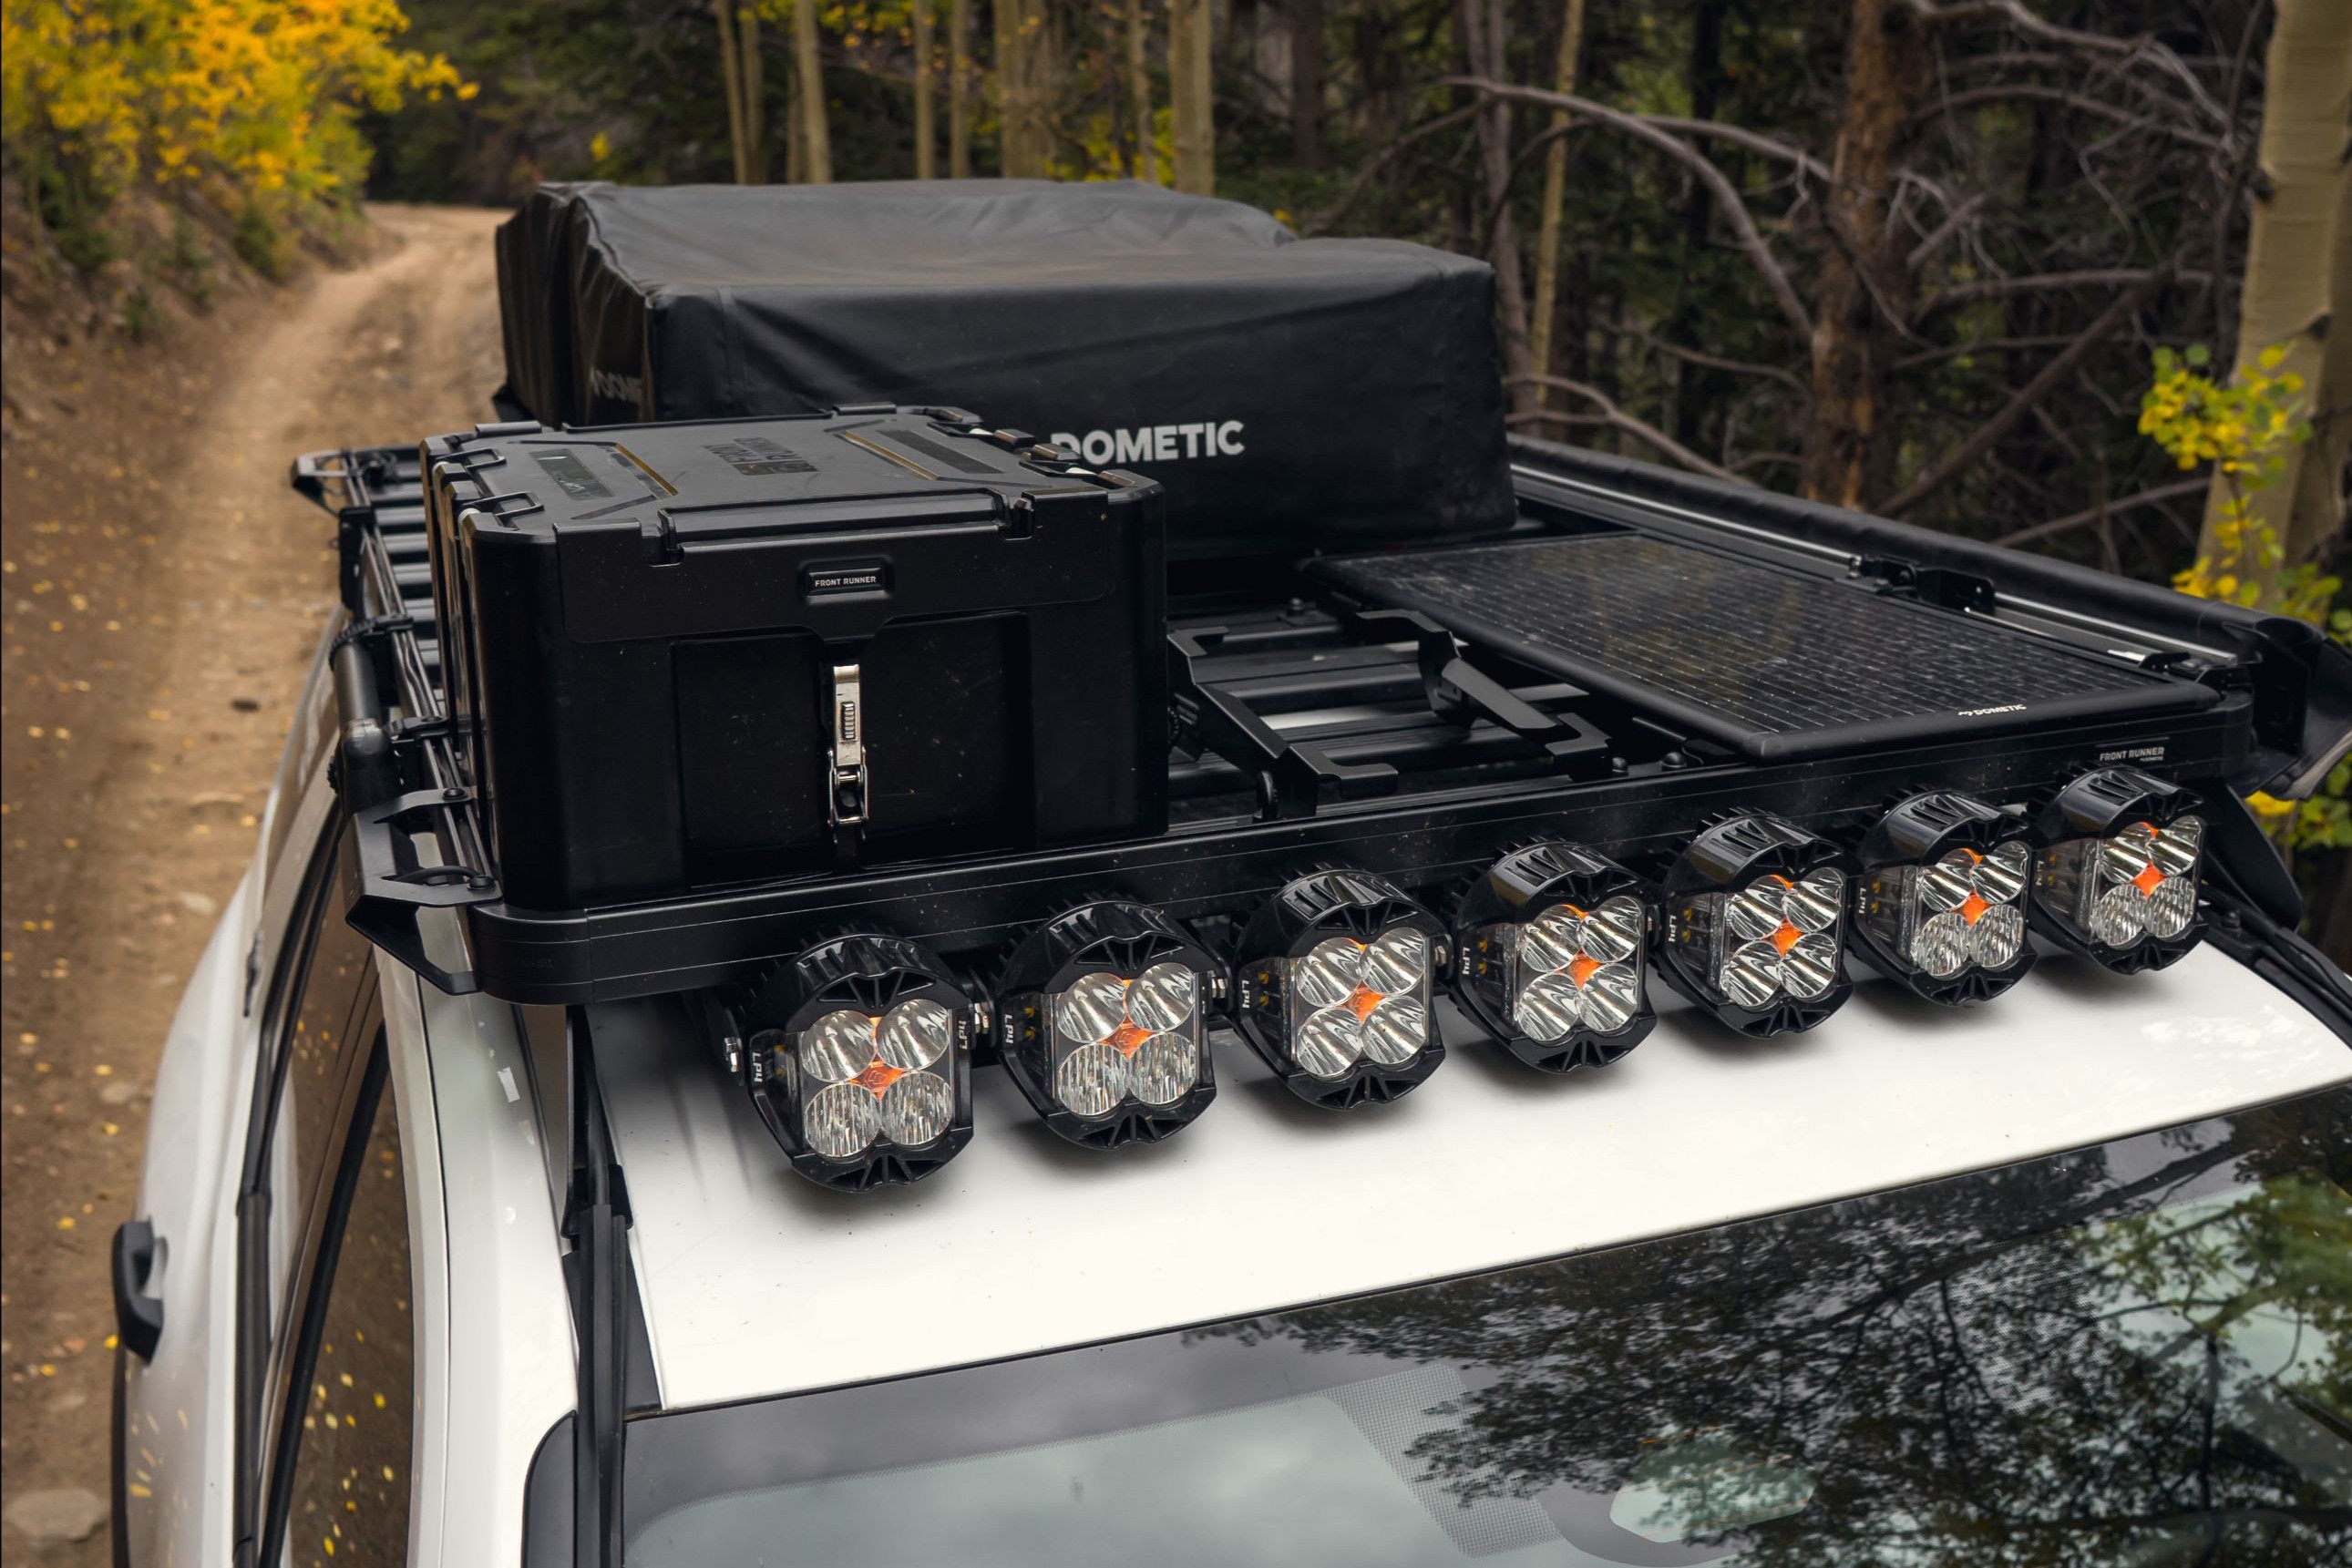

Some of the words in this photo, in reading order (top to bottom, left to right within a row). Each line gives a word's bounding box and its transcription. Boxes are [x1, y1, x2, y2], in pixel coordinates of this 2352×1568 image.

[1051, 420, 1245, 465] DOMETIC
[815, 579, 841, 587] FRONT
[844, 576, 877, 585] RUNNER
[2100, 751, 2128, 762] FRONT
[2129, 747, 2165, 758] RUNNER
[1668, 915, 1678, 942] LP4
[1462, 947, 1471, 975] LP4
[1241, 979, 1250, 1009] LP4
[1004, 1013, 1014, 1044] LP4
[752, 1051, 764, 1082] LP4
